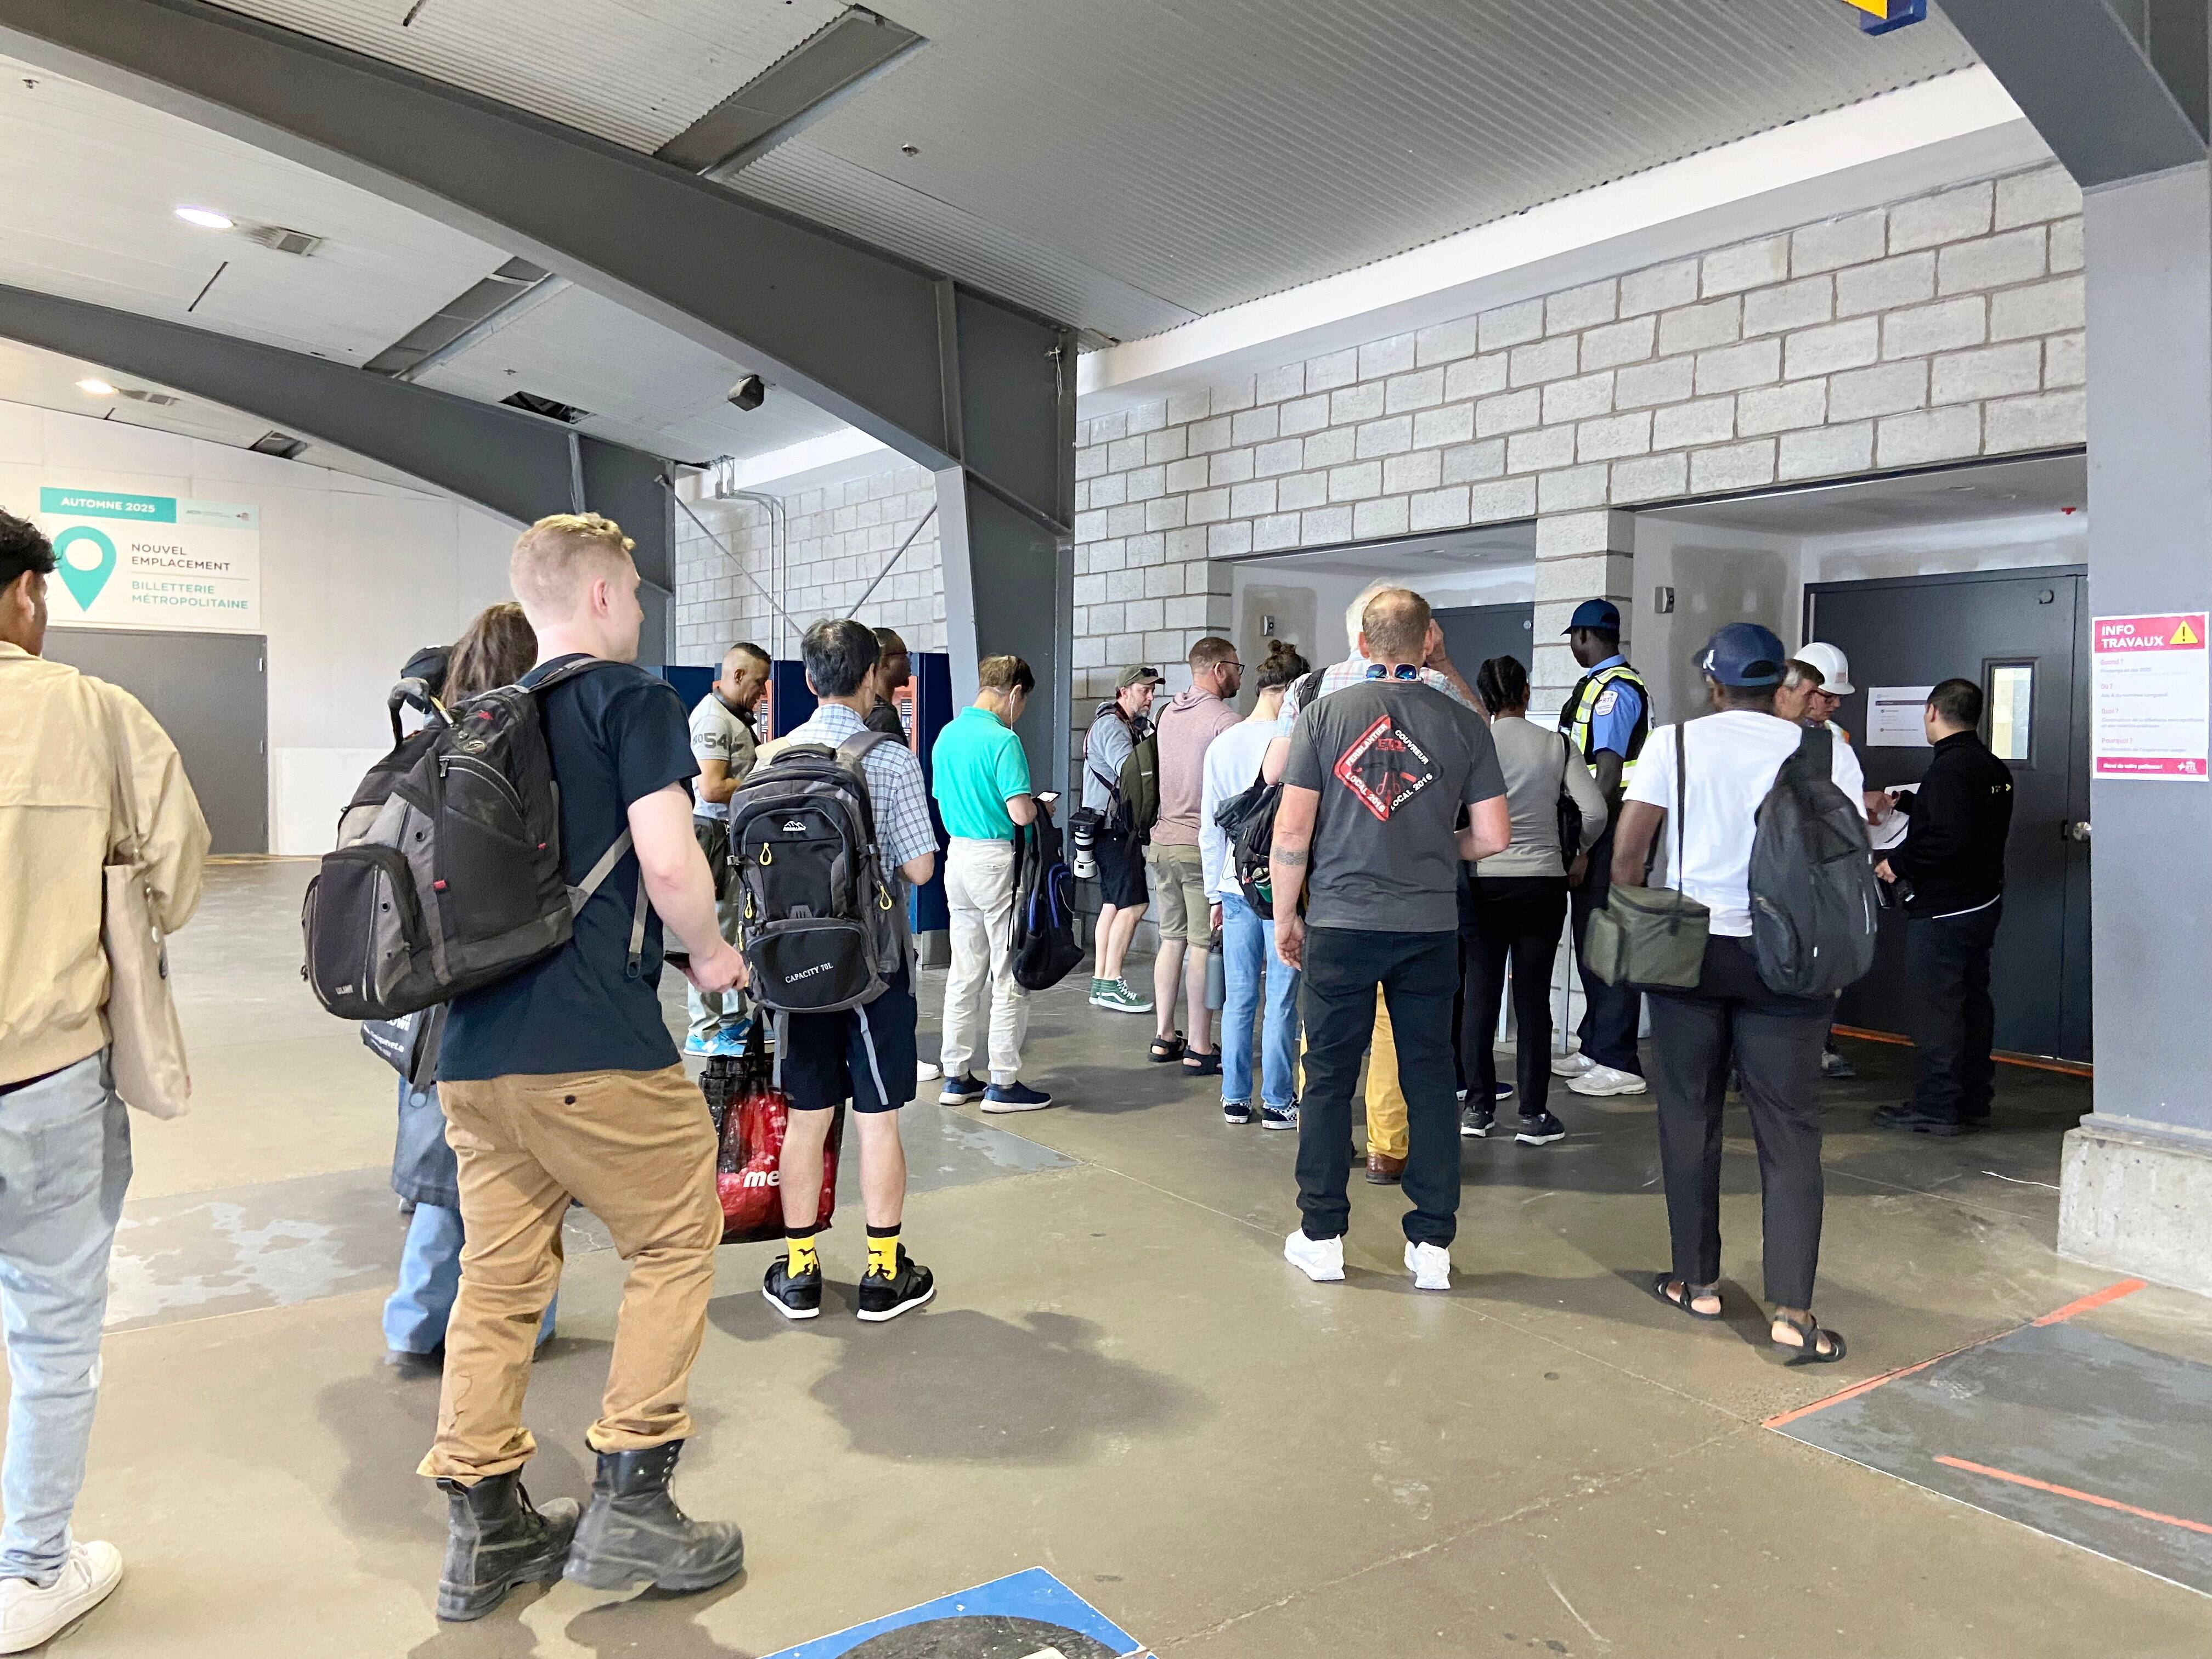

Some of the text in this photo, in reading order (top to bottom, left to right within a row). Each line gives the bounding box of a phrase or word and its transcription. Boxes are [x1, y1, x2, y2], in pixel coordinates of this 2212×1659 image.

[61, 498, 156, 514] AUTOMNE 2025
[132, 544, 187, 556] NOUVEL
[132, 556, 231, 571] EMPLACEMENT
[132, 581, 215, 594] BILLETTERIE
[132, 594, 249, 610] MÉTROPOLITAINE
[2102, 624, 2135, 636] INFO
[2101, 636, 2164, 648] TRAVAUX
[1345, 723, 1388, 766] FERBLANTIER
[1395, 729, 1430, 765] COUVREUR
[1345, 772, 1386, 813] LOCAL 2016
[1390, 772, 1434, 811] LOCAL 2016
[785, 962, 834, 983] CAPACITY 70L
[743, 1170, 779, 1188] me
